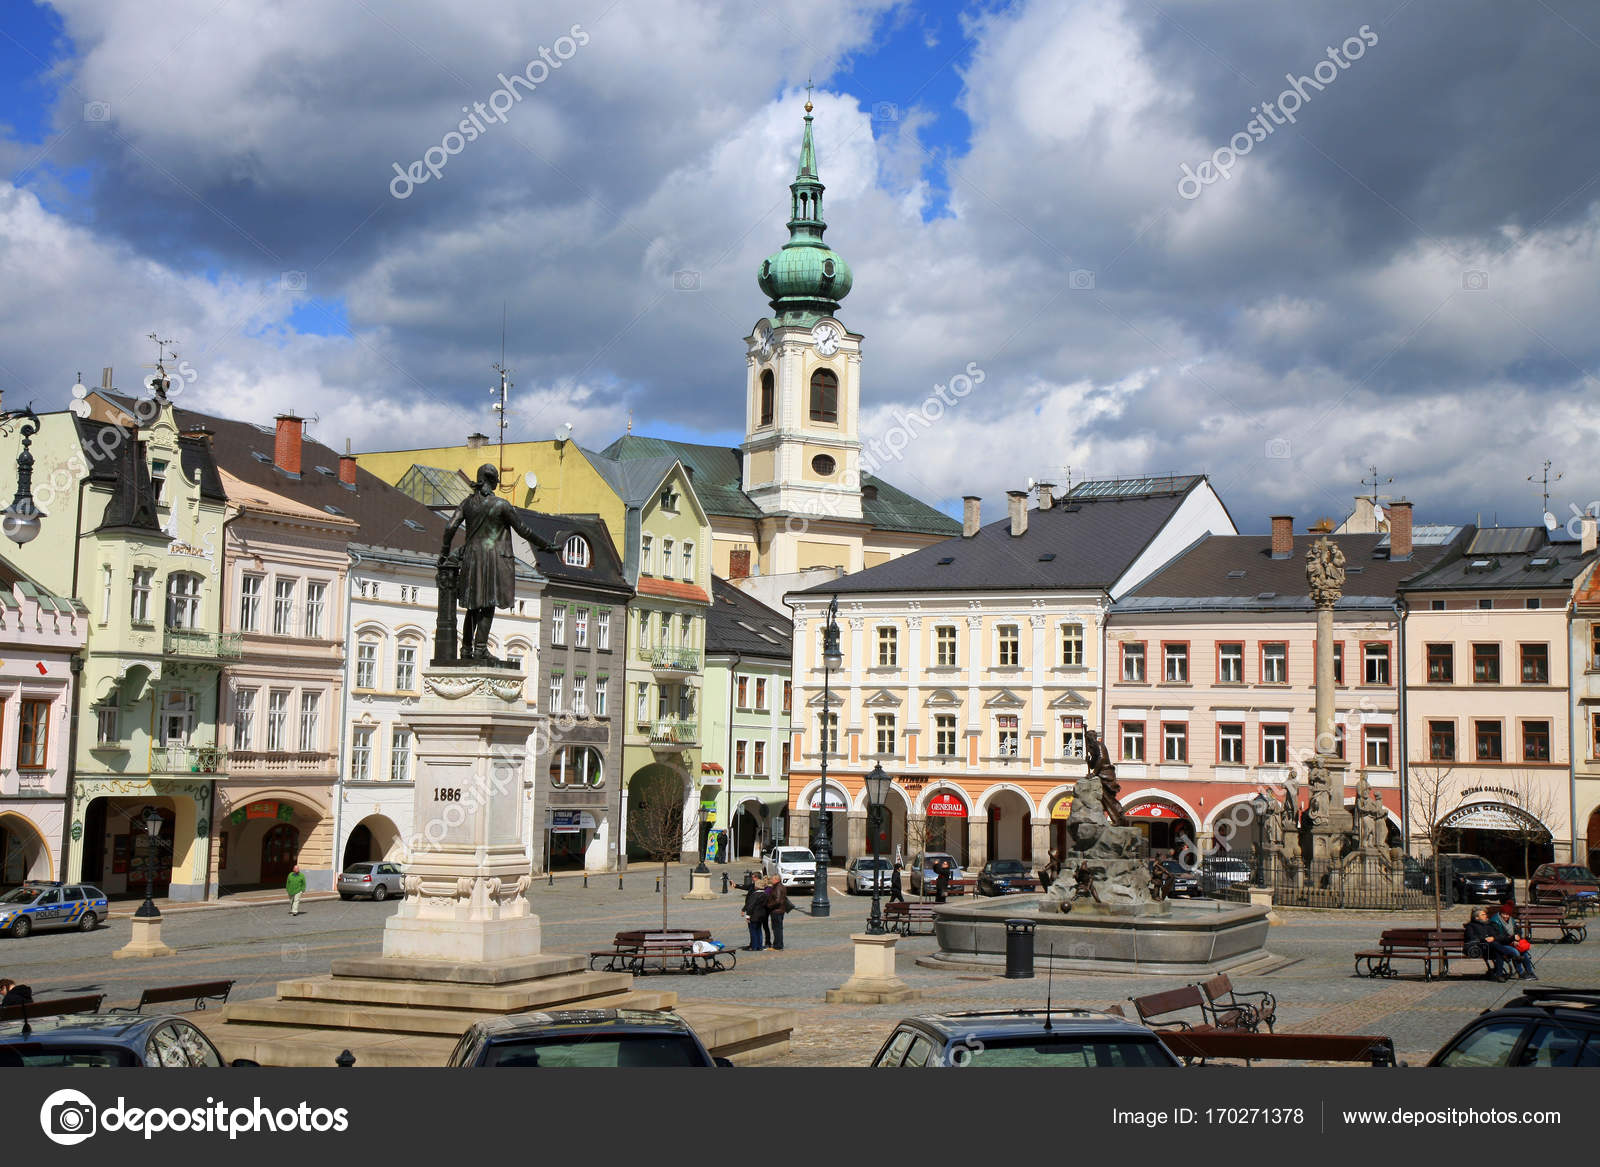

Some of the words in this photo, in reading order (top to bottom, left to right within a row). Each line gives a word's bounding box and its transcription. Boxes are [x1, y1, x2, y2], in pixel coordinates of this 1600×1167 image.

[434, 788, 461, 802] 1886
[931, 803, 962, 811] GENERALI
[36, 910, 60, 918] POLICIE
